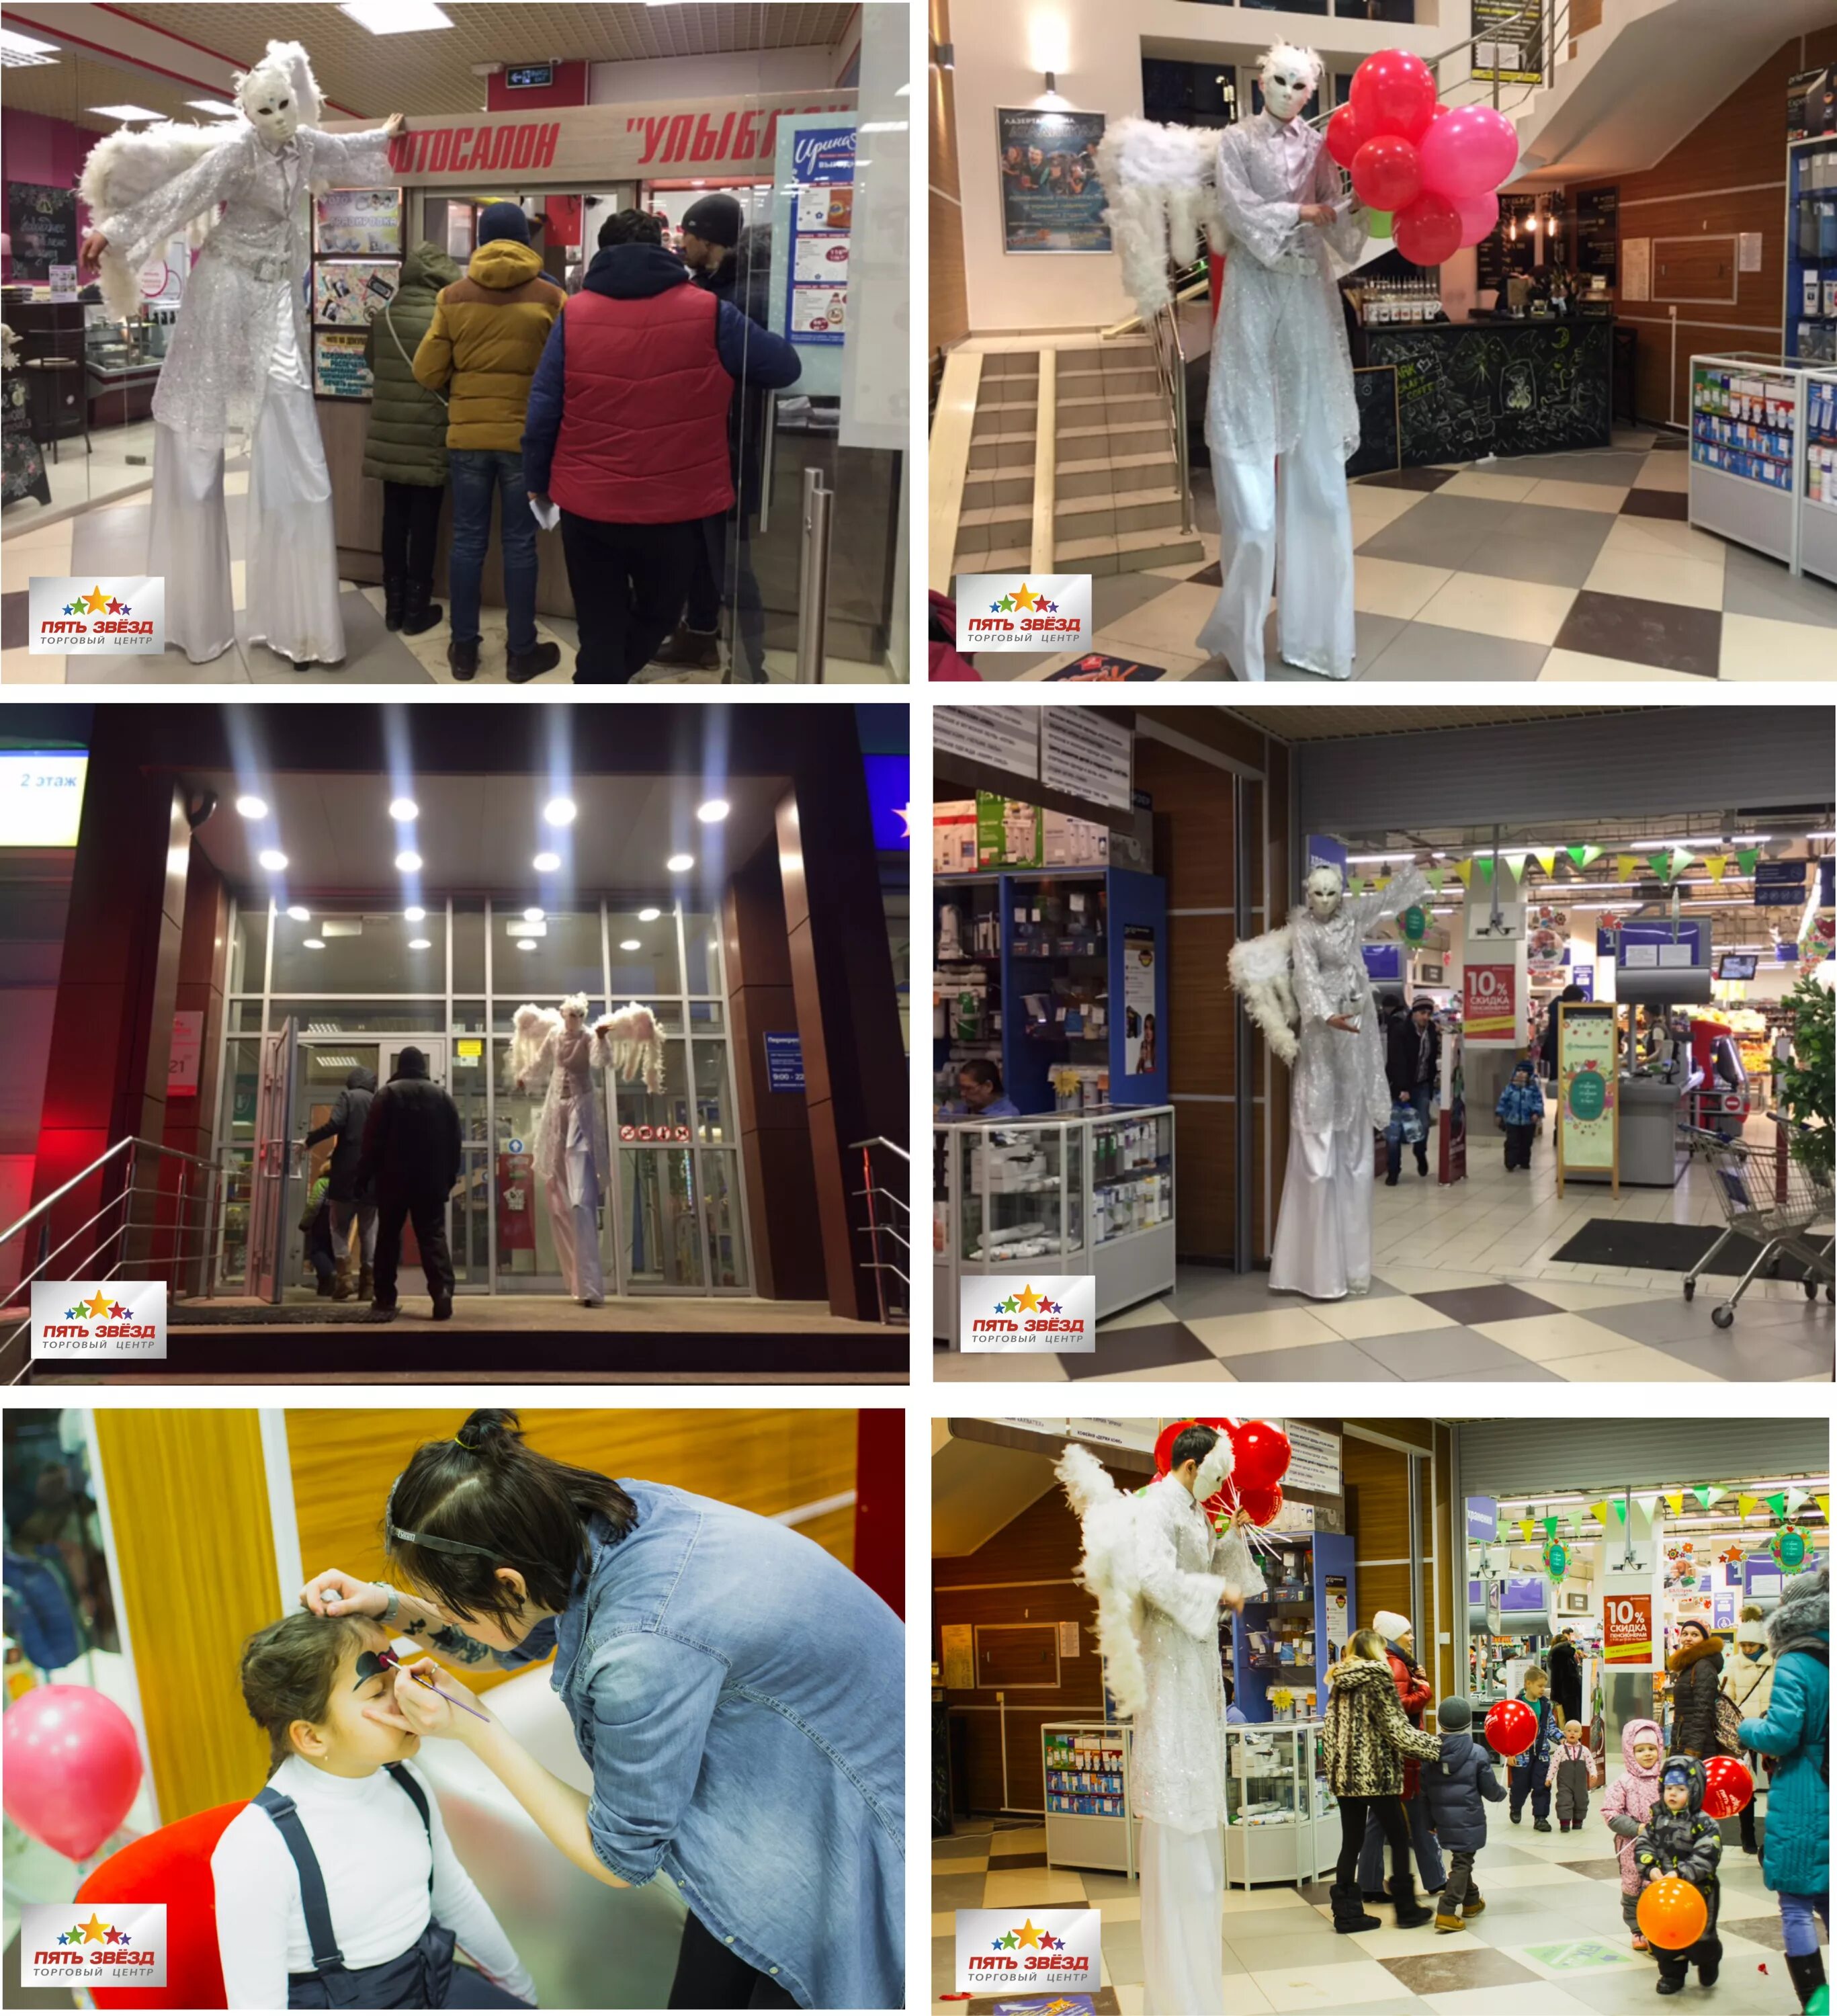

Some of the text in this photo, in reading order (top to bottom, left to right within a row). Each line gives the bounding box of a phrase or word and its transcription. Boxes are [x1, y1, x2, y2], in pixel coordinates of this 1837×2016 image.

[387, 122, 561, 173] ОТОСАЛОН
[20, 773, 77, 787] 2 этаж
[1470, 997, 1510, 1005] СКИДКА
[169, 1060, 185, 1074] 21
[1610, 1624, 1647, 1633] СКИДКА
